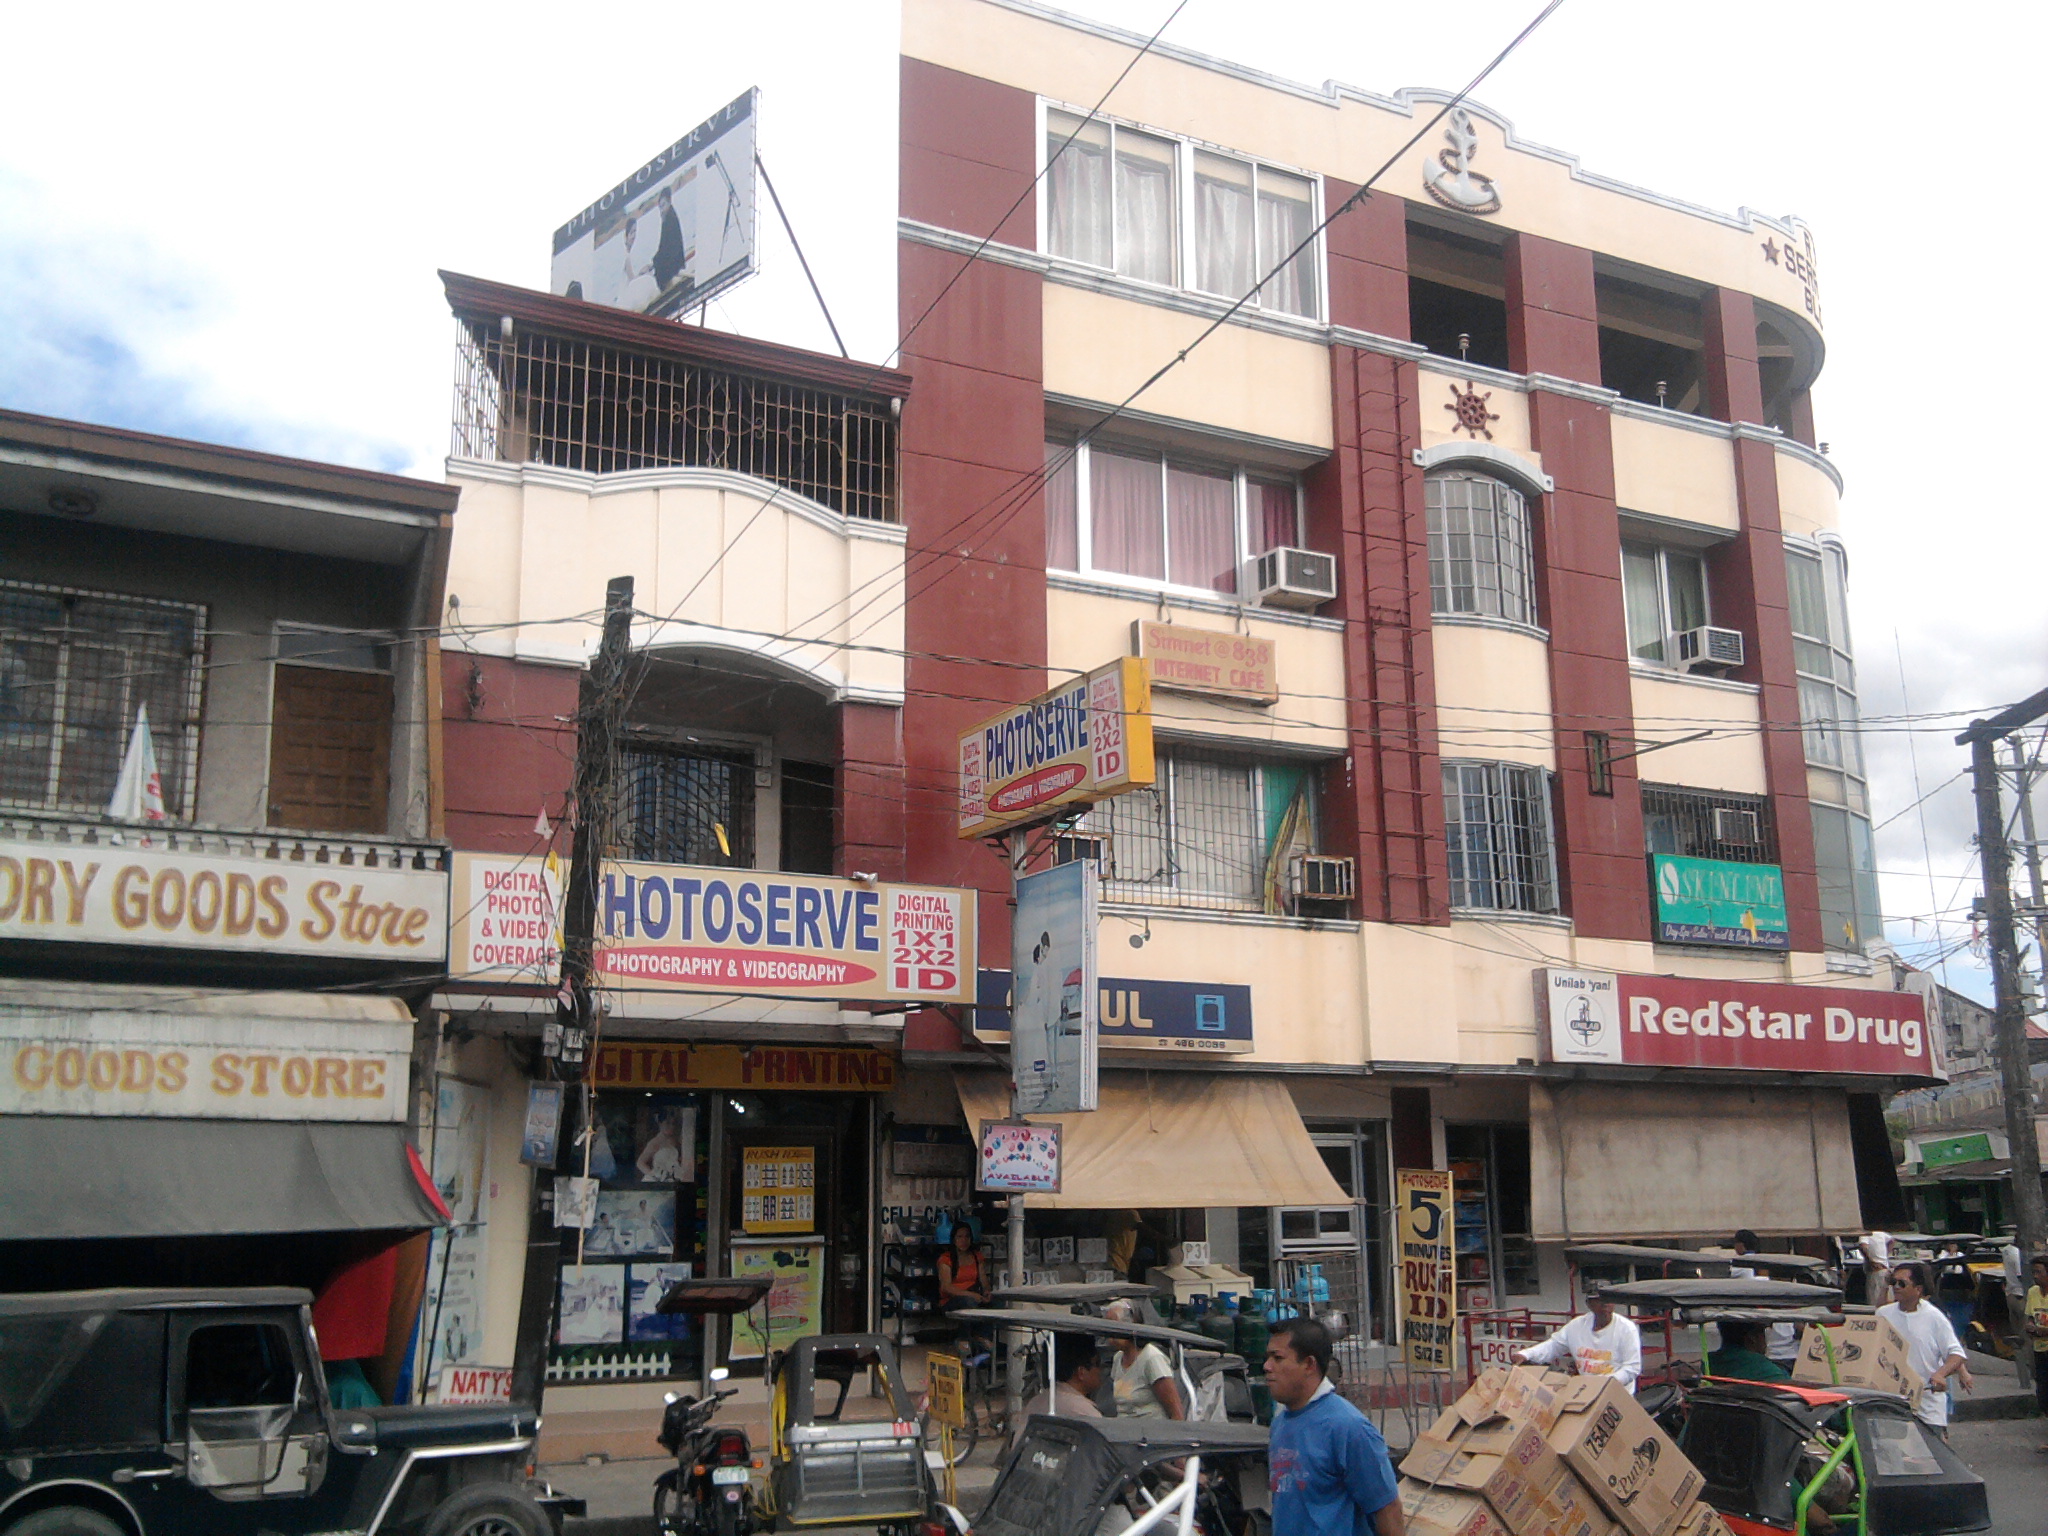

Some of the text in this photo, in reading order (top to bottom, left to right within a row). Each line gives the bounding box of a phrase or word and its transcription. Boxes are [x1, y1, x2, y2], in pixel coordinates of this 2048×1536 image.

[567, 102, 738, 237] PHOTOSERVE
[1213, 639, 1231, 659] @
[1232, 640, 1269, 668] 838
[1154, 657, 1221, 683] INTERNET
[986, 686, 1089, 784] PHOTOSERVE
[1093, 713, 1120, 736] 1X1
[1094, 729, 1121, 753] 2X2
[1097, 751, 1121, 777] ID
[484, 870, 546, 893] DIGITA
[0, 856, 431, 947] DRY GOODS Store
[599, 873, 879, 952] HOTOSERVE
[897, 893, 951, 914] DIGITAL
[481, 918, 549, 940] & VIDEO
[894, 911, 954, 932] PRINTING
[891, 930, 955, 948] 1X1
[473, 943, 556, 967] COVERAGE
[893, 947, 956, 966] 2X2
[606, 954, 846, 984] PHOTOGRAPHY & VIDEOGRAPHY
[894, 968, 957, 990] ID
[1554, 975, 1586, 989] Unilab
[1628, 995, 1923, 1058] RedStar Drug
[13, 1046, 387, 1099] GOODS STORE
[741, 1049, 893, 1086] PRINTING
[1410, 1189, 1443, 1240] 5
[1404, 1241, 1452, 1261] MINUTES
[1405, 1260, 1453, 1295] RUSH
[1409, 1293, 1448, 1320] ID
[1414, 1345, 1444, 1364] SIZE
[1480, 1341, 1506, 1363] LPG
[451, 1370, 513, 1396] NATY'S
